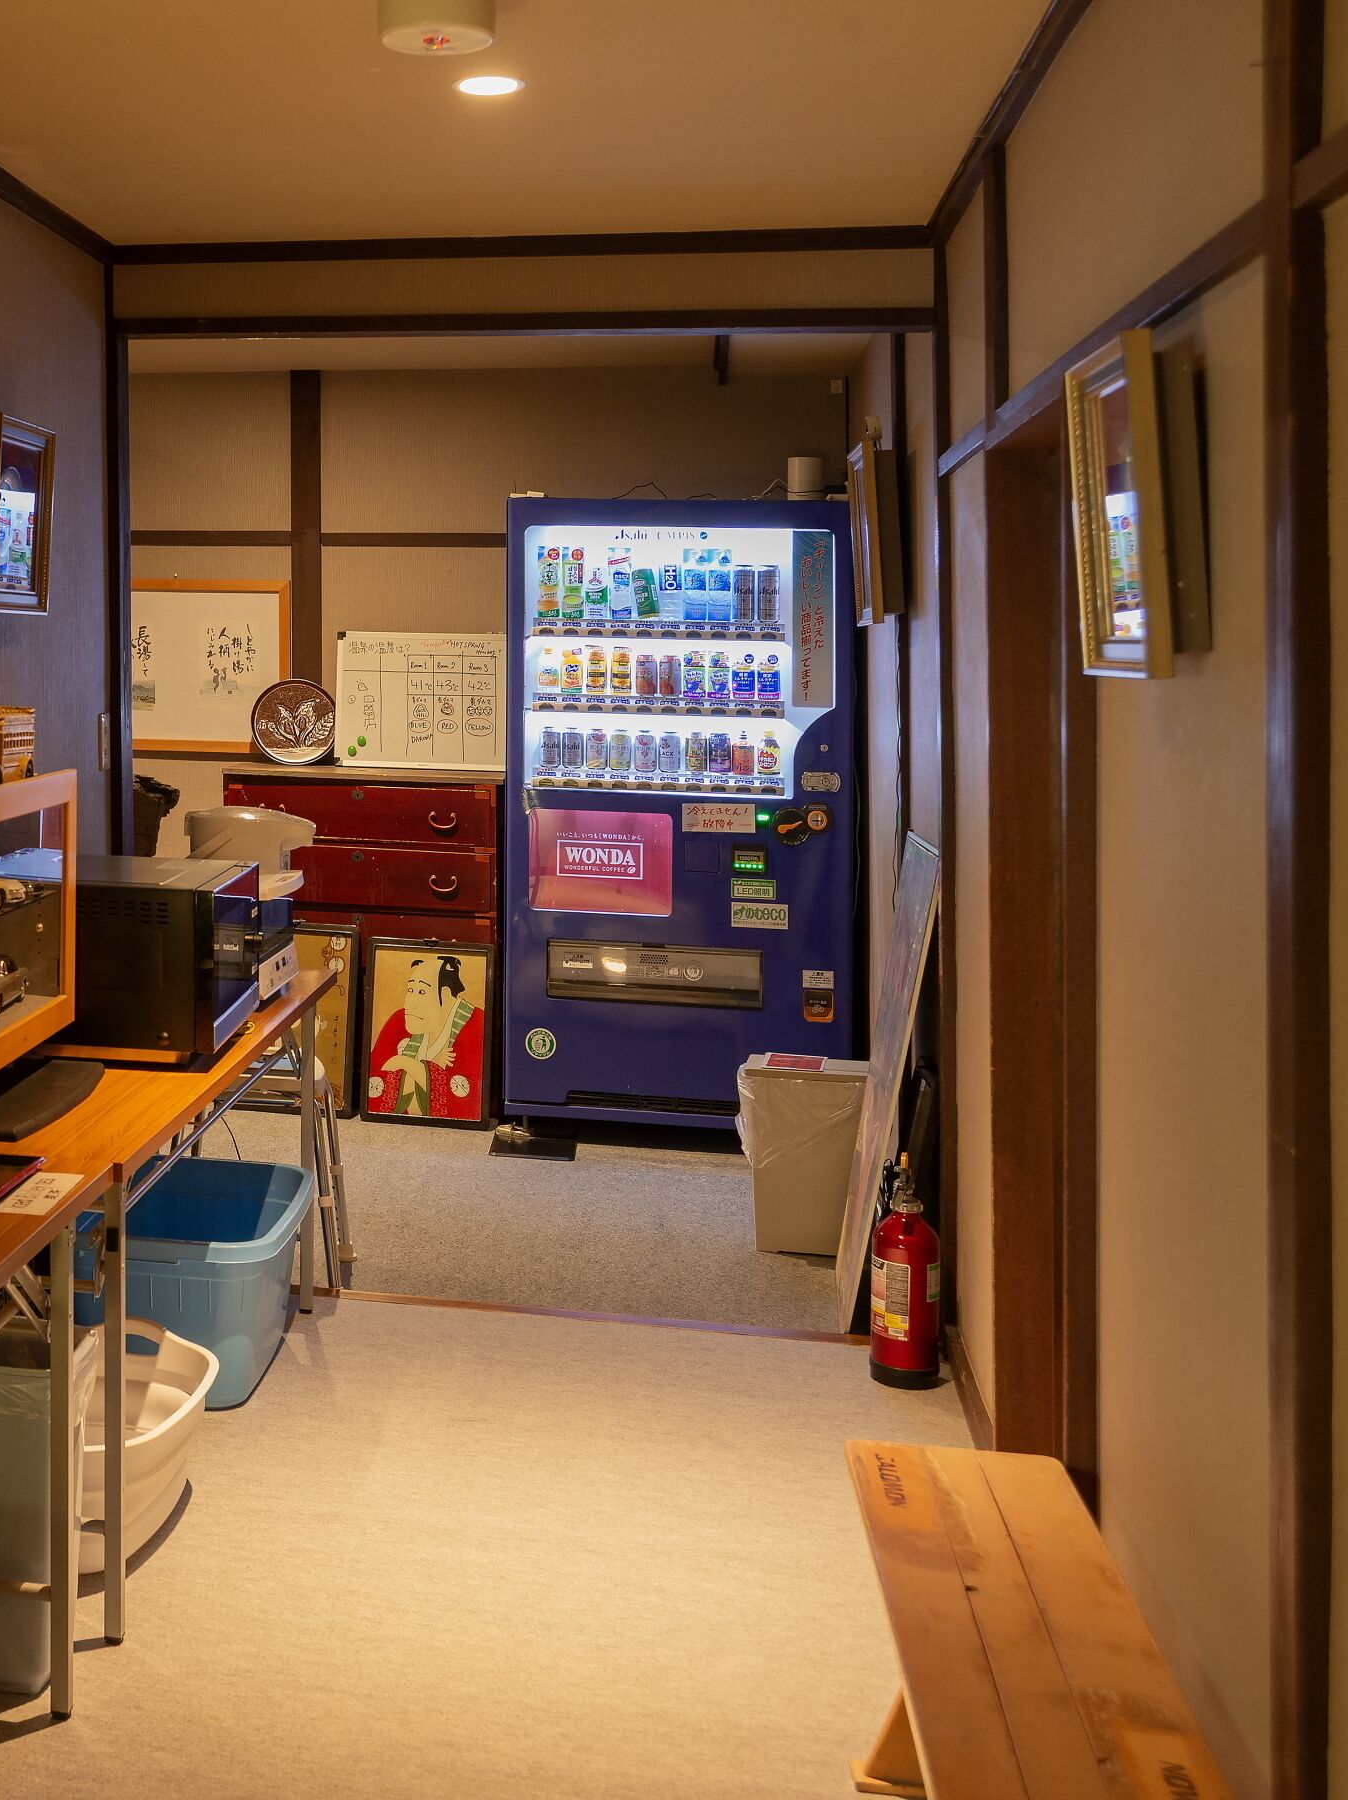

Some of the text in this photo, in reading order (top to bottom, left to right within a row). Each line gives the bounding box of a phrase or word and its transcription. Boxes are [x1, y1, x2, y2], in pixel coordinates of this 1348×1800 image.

[483, 664, 489, 672] 3
[441, 722, 454, 730] RED
[564, 846, 636, 866] WONDA
[564, 864, 600, 872] WONDERFUL
[736, 887, 770, 897] LED照明
